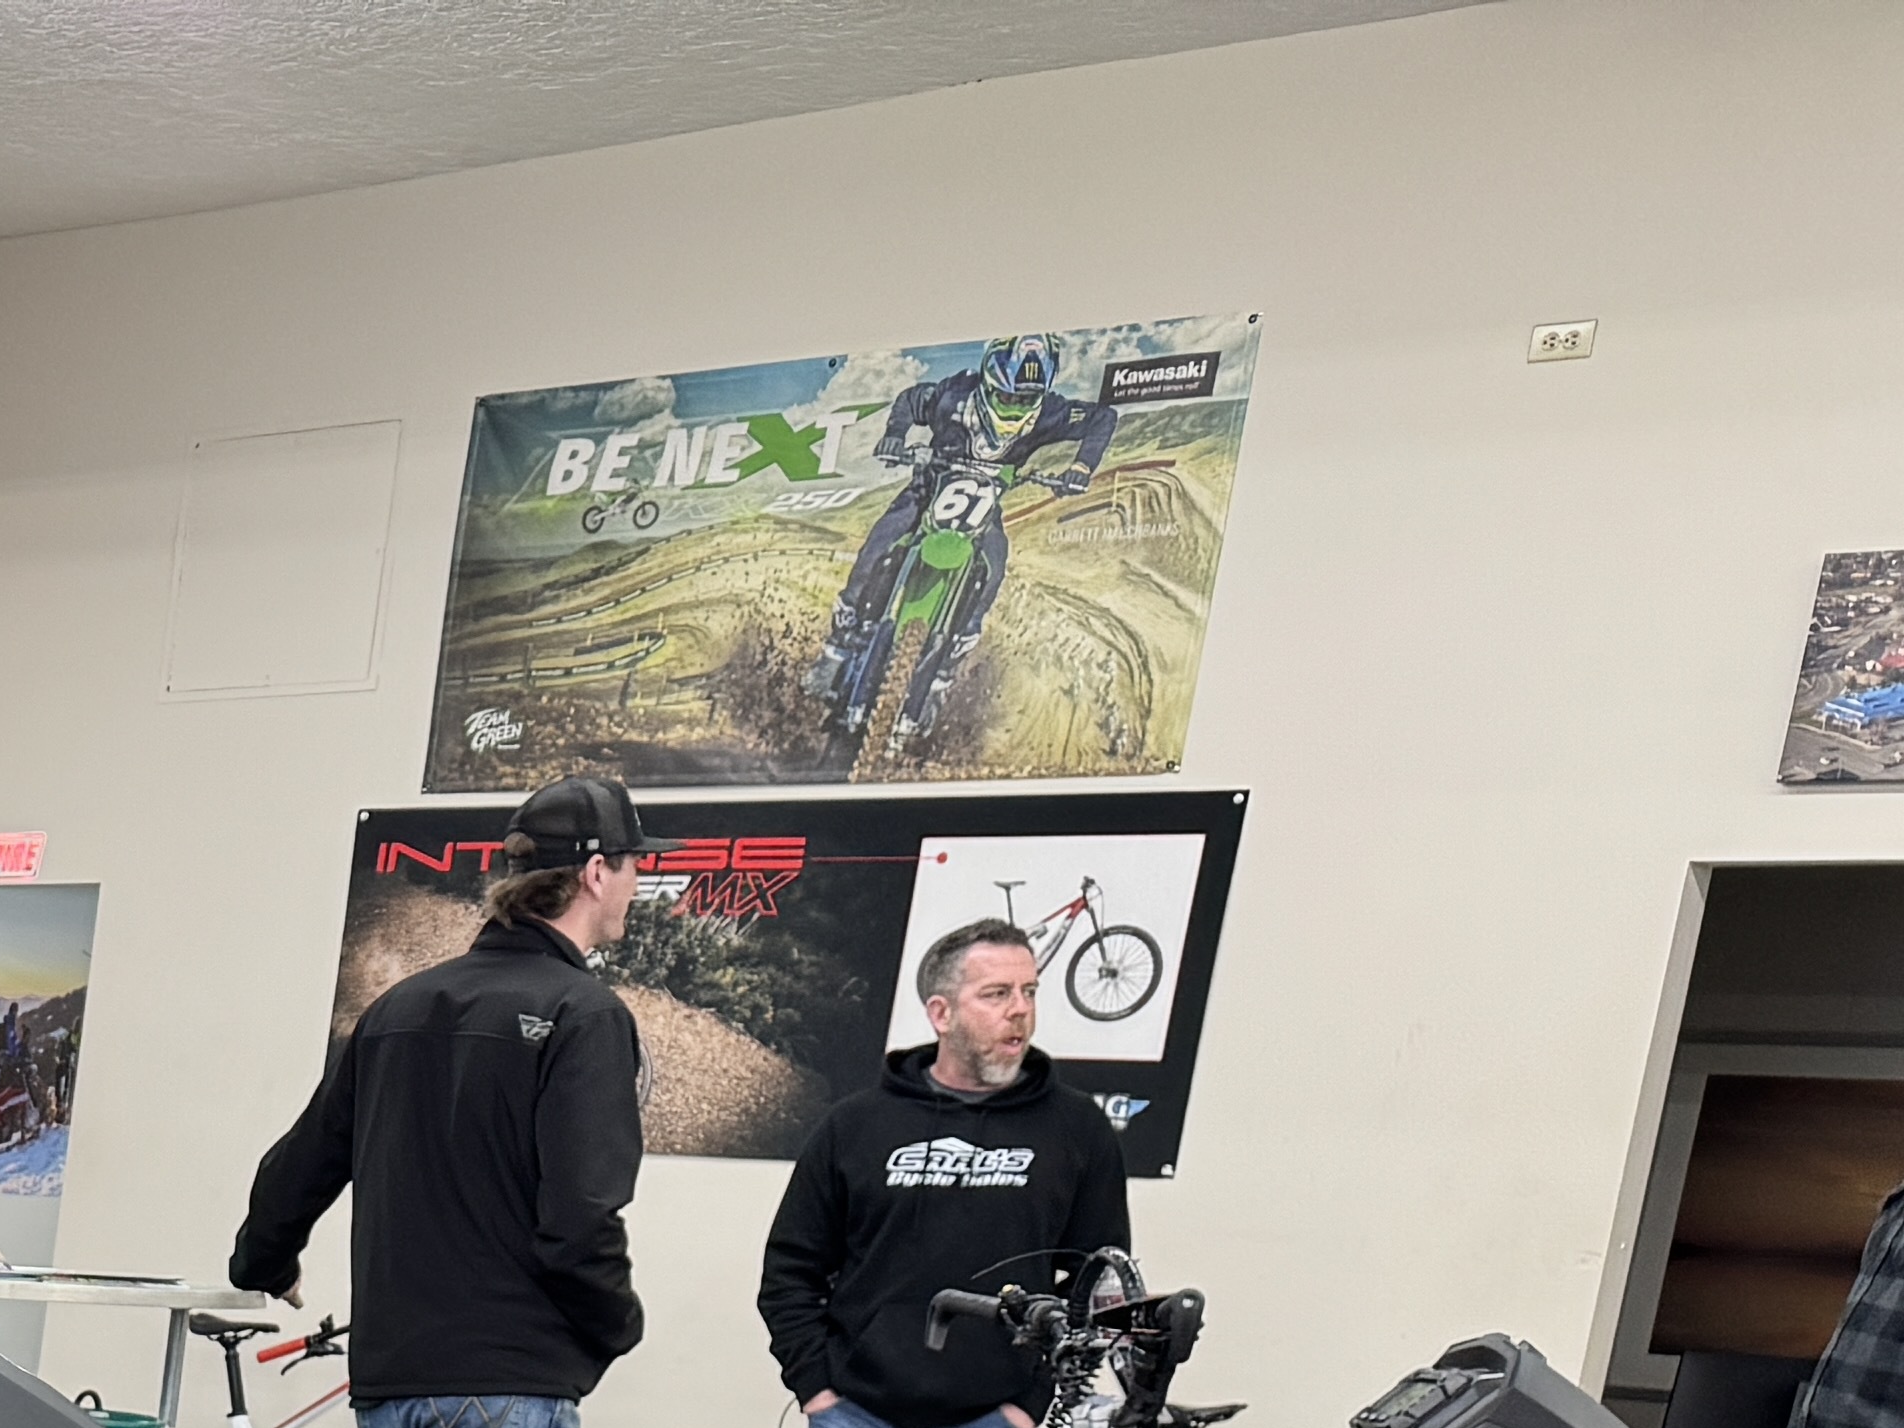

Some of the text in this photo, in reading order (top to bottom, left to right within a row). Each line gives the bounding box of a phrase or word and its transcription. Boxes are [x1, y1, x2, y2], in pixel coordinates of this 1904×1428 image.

[1112, 360, 1207, 387] Kawasaki
[546, 401, 891, 496] BE NEXT
[761, 488, 864, 514] 250
[934, 479, 1002, 527] 61
[465, 708, 511, 732] TEAM
[471, 722, 524, 752] GREEN
[672, 870, 801, 918] MX
